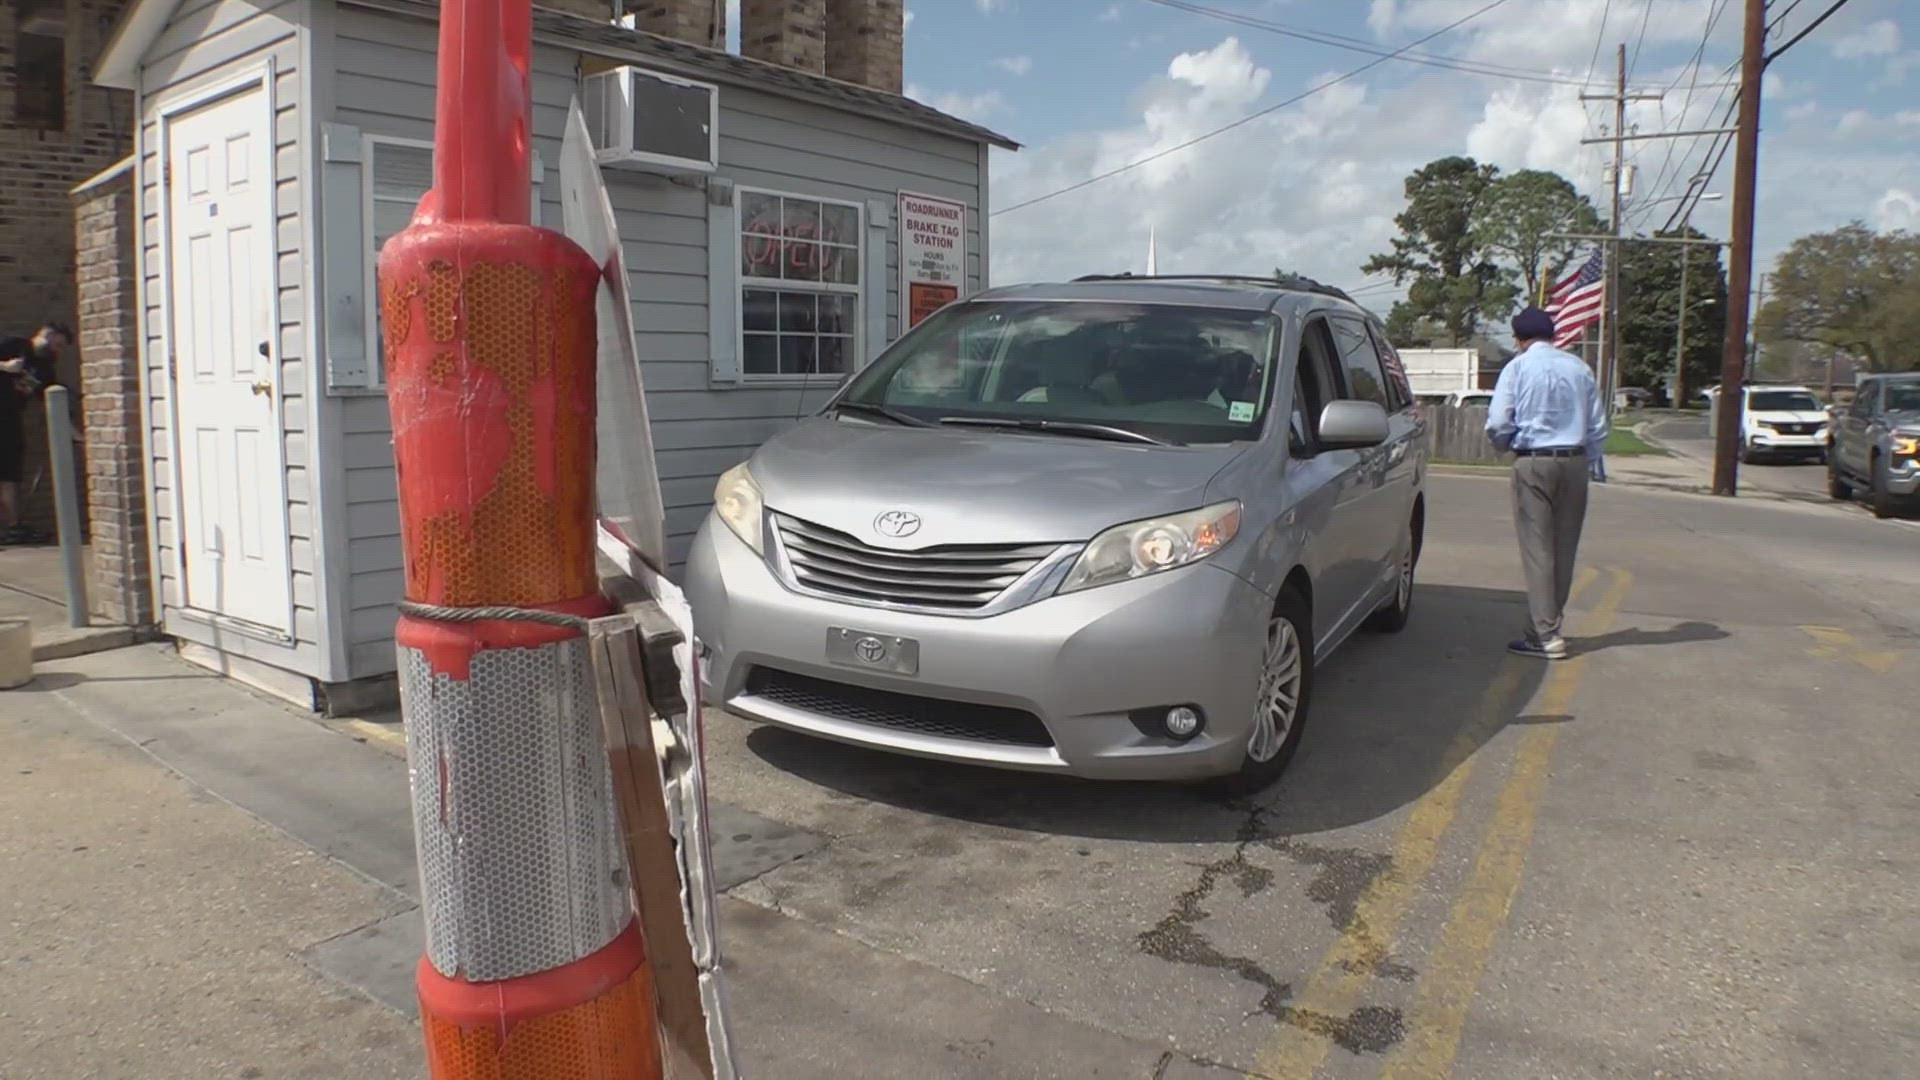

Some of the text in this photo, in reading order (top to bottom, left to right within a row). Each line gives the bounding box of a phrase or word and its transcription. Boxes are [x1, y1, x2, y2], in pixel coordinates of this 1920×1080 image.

[906, 201, 959, 220] ROADRUNNER
[907, 219, 959, 238] BRAKE TAG
[744, 220, 834, 271] OPEN
[913, 233, 953, 249] STATION
